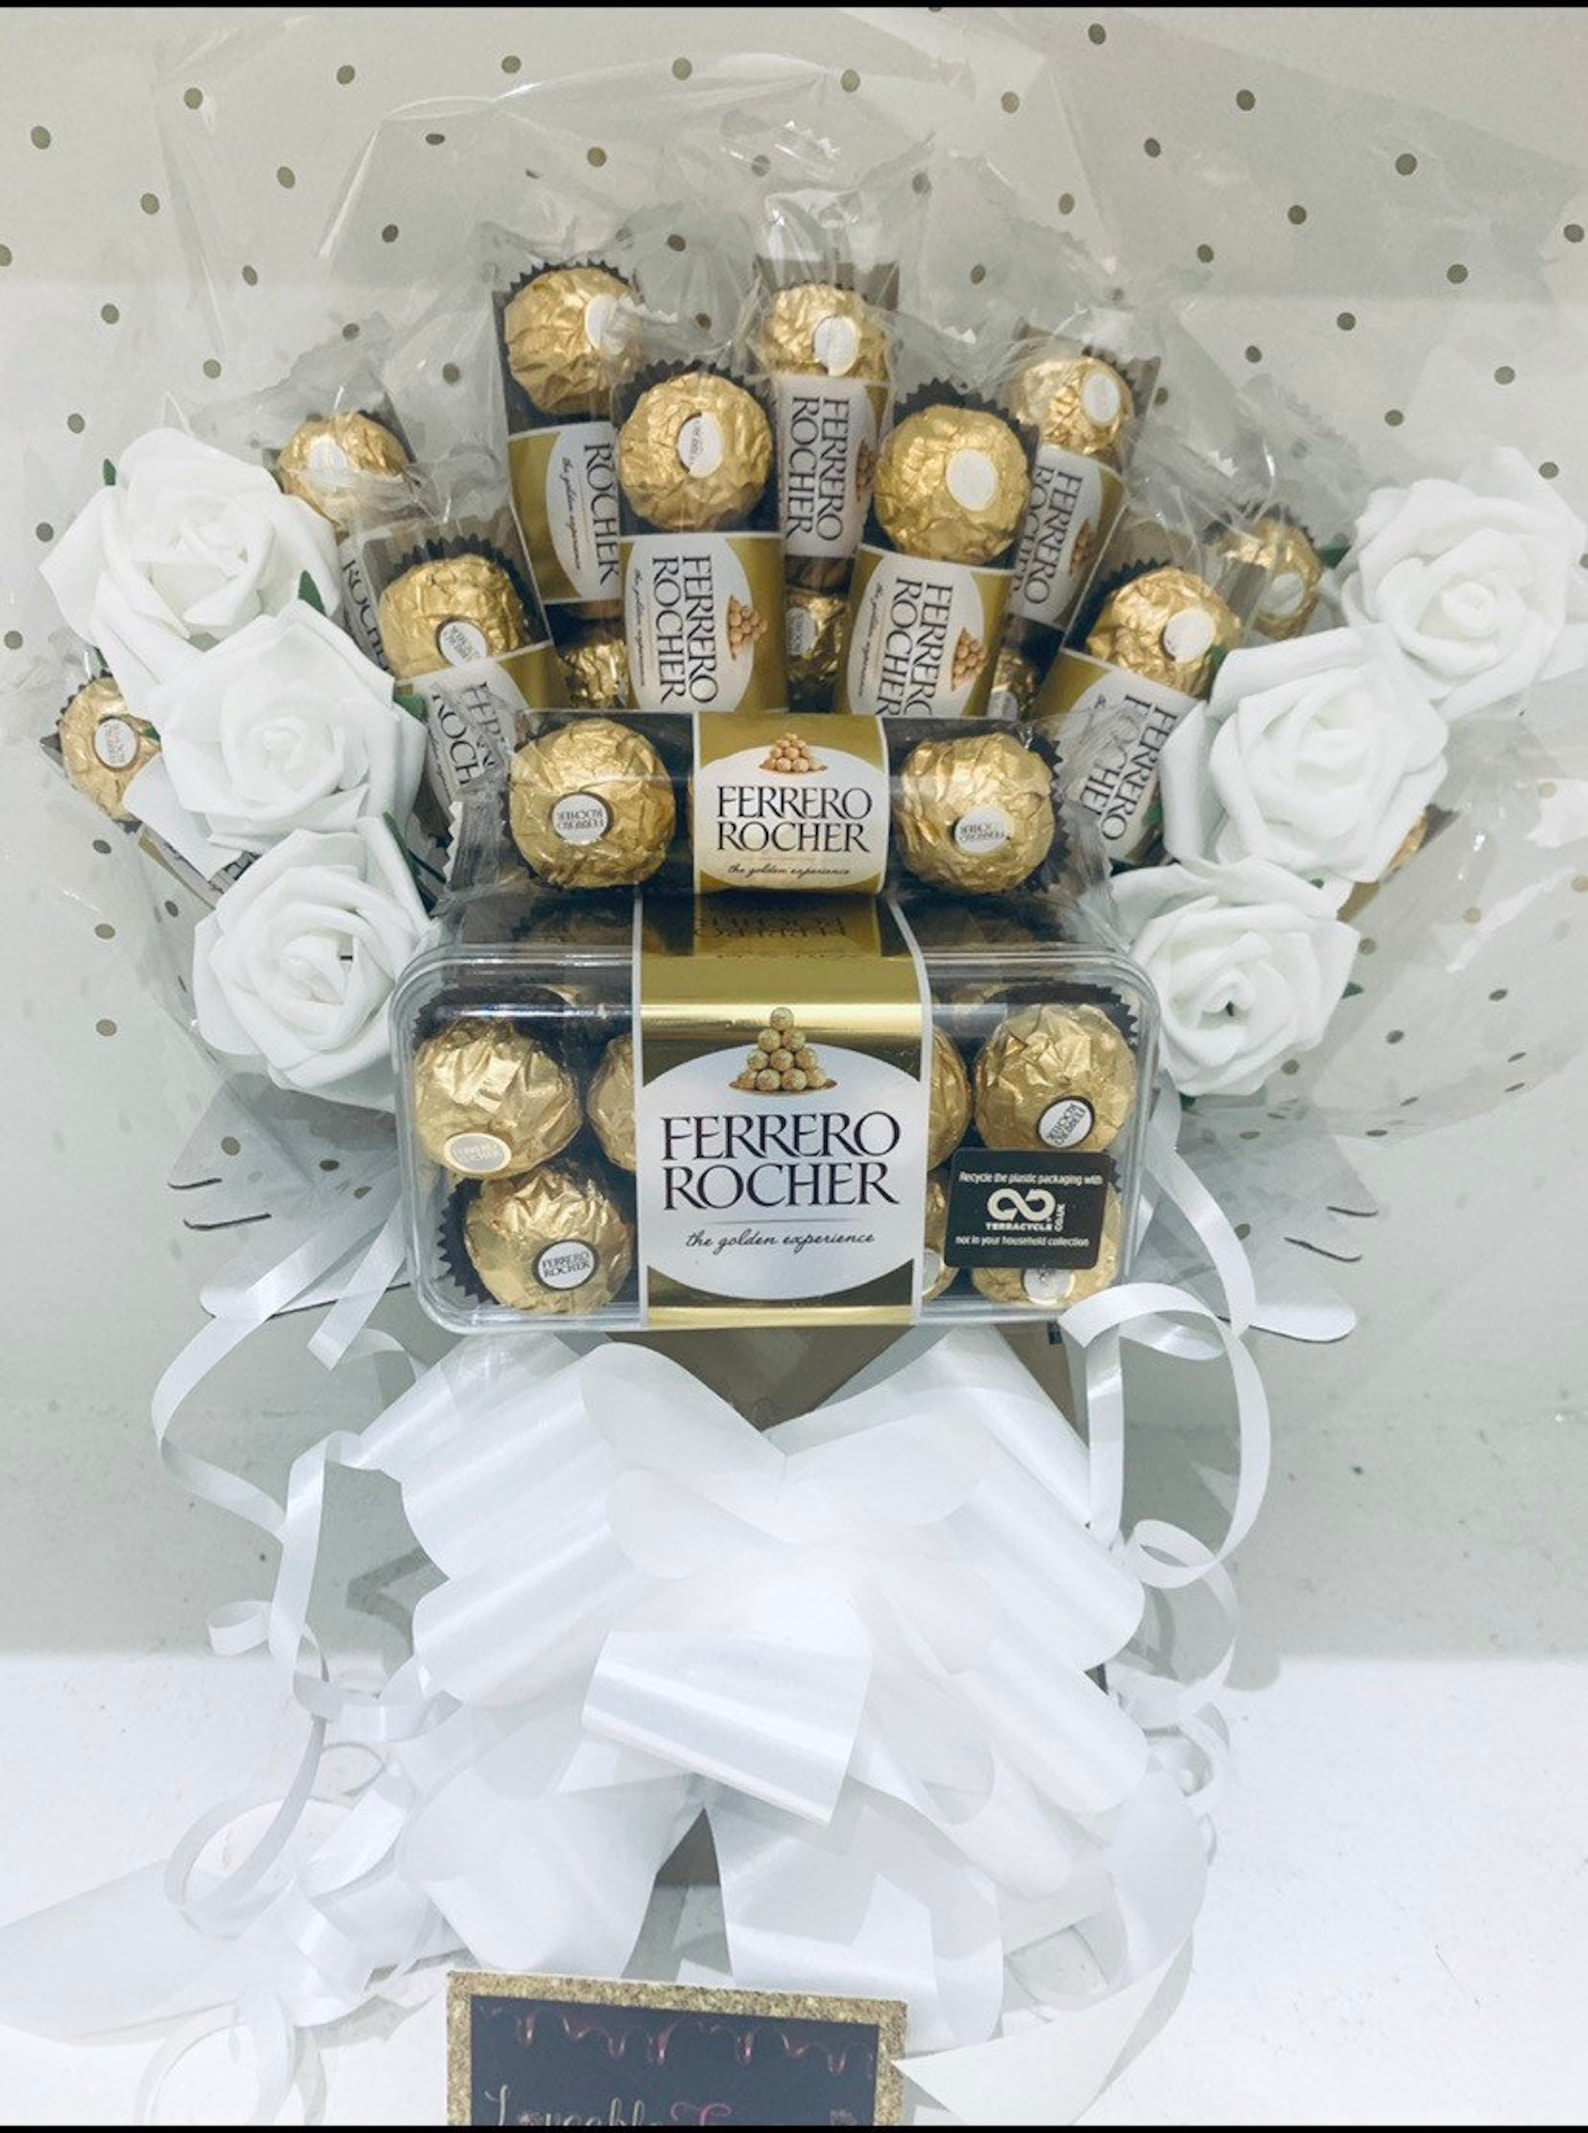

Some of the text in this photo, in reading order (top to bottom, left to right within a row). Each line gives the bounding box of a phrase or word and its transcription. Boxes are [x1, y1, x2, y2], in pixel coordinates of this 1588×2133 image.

[786, 397, 820, 540] ROCHER
[816, 398, 850, 541] FERRERO
[1024, 471, 1084, 604] FERRERO
[652, 556, 687, 704] ROCHER
[683, 554, 719, 704] FERRERO
[876, 577, 923, 716] ROCHER
[1080, 694, 1151, 815] OCHE
[1102, 706, 1178, 840] FERRERO
[717, 785, 873, 820] FERRERO
[717, 821, 871, 853] ROCHER
[728, 862, 850, 879] the golden experience
[660, 1110, 901, 1161] FERRERO
[958, 1171, 1104, 1186] Recycle the plastic packaging with
[662, 1161, 901, 1211] ROCHER
[686, 1228, 876, 1255] the golden experience
[955, 1235, 1090, 1247] not in your household collection
